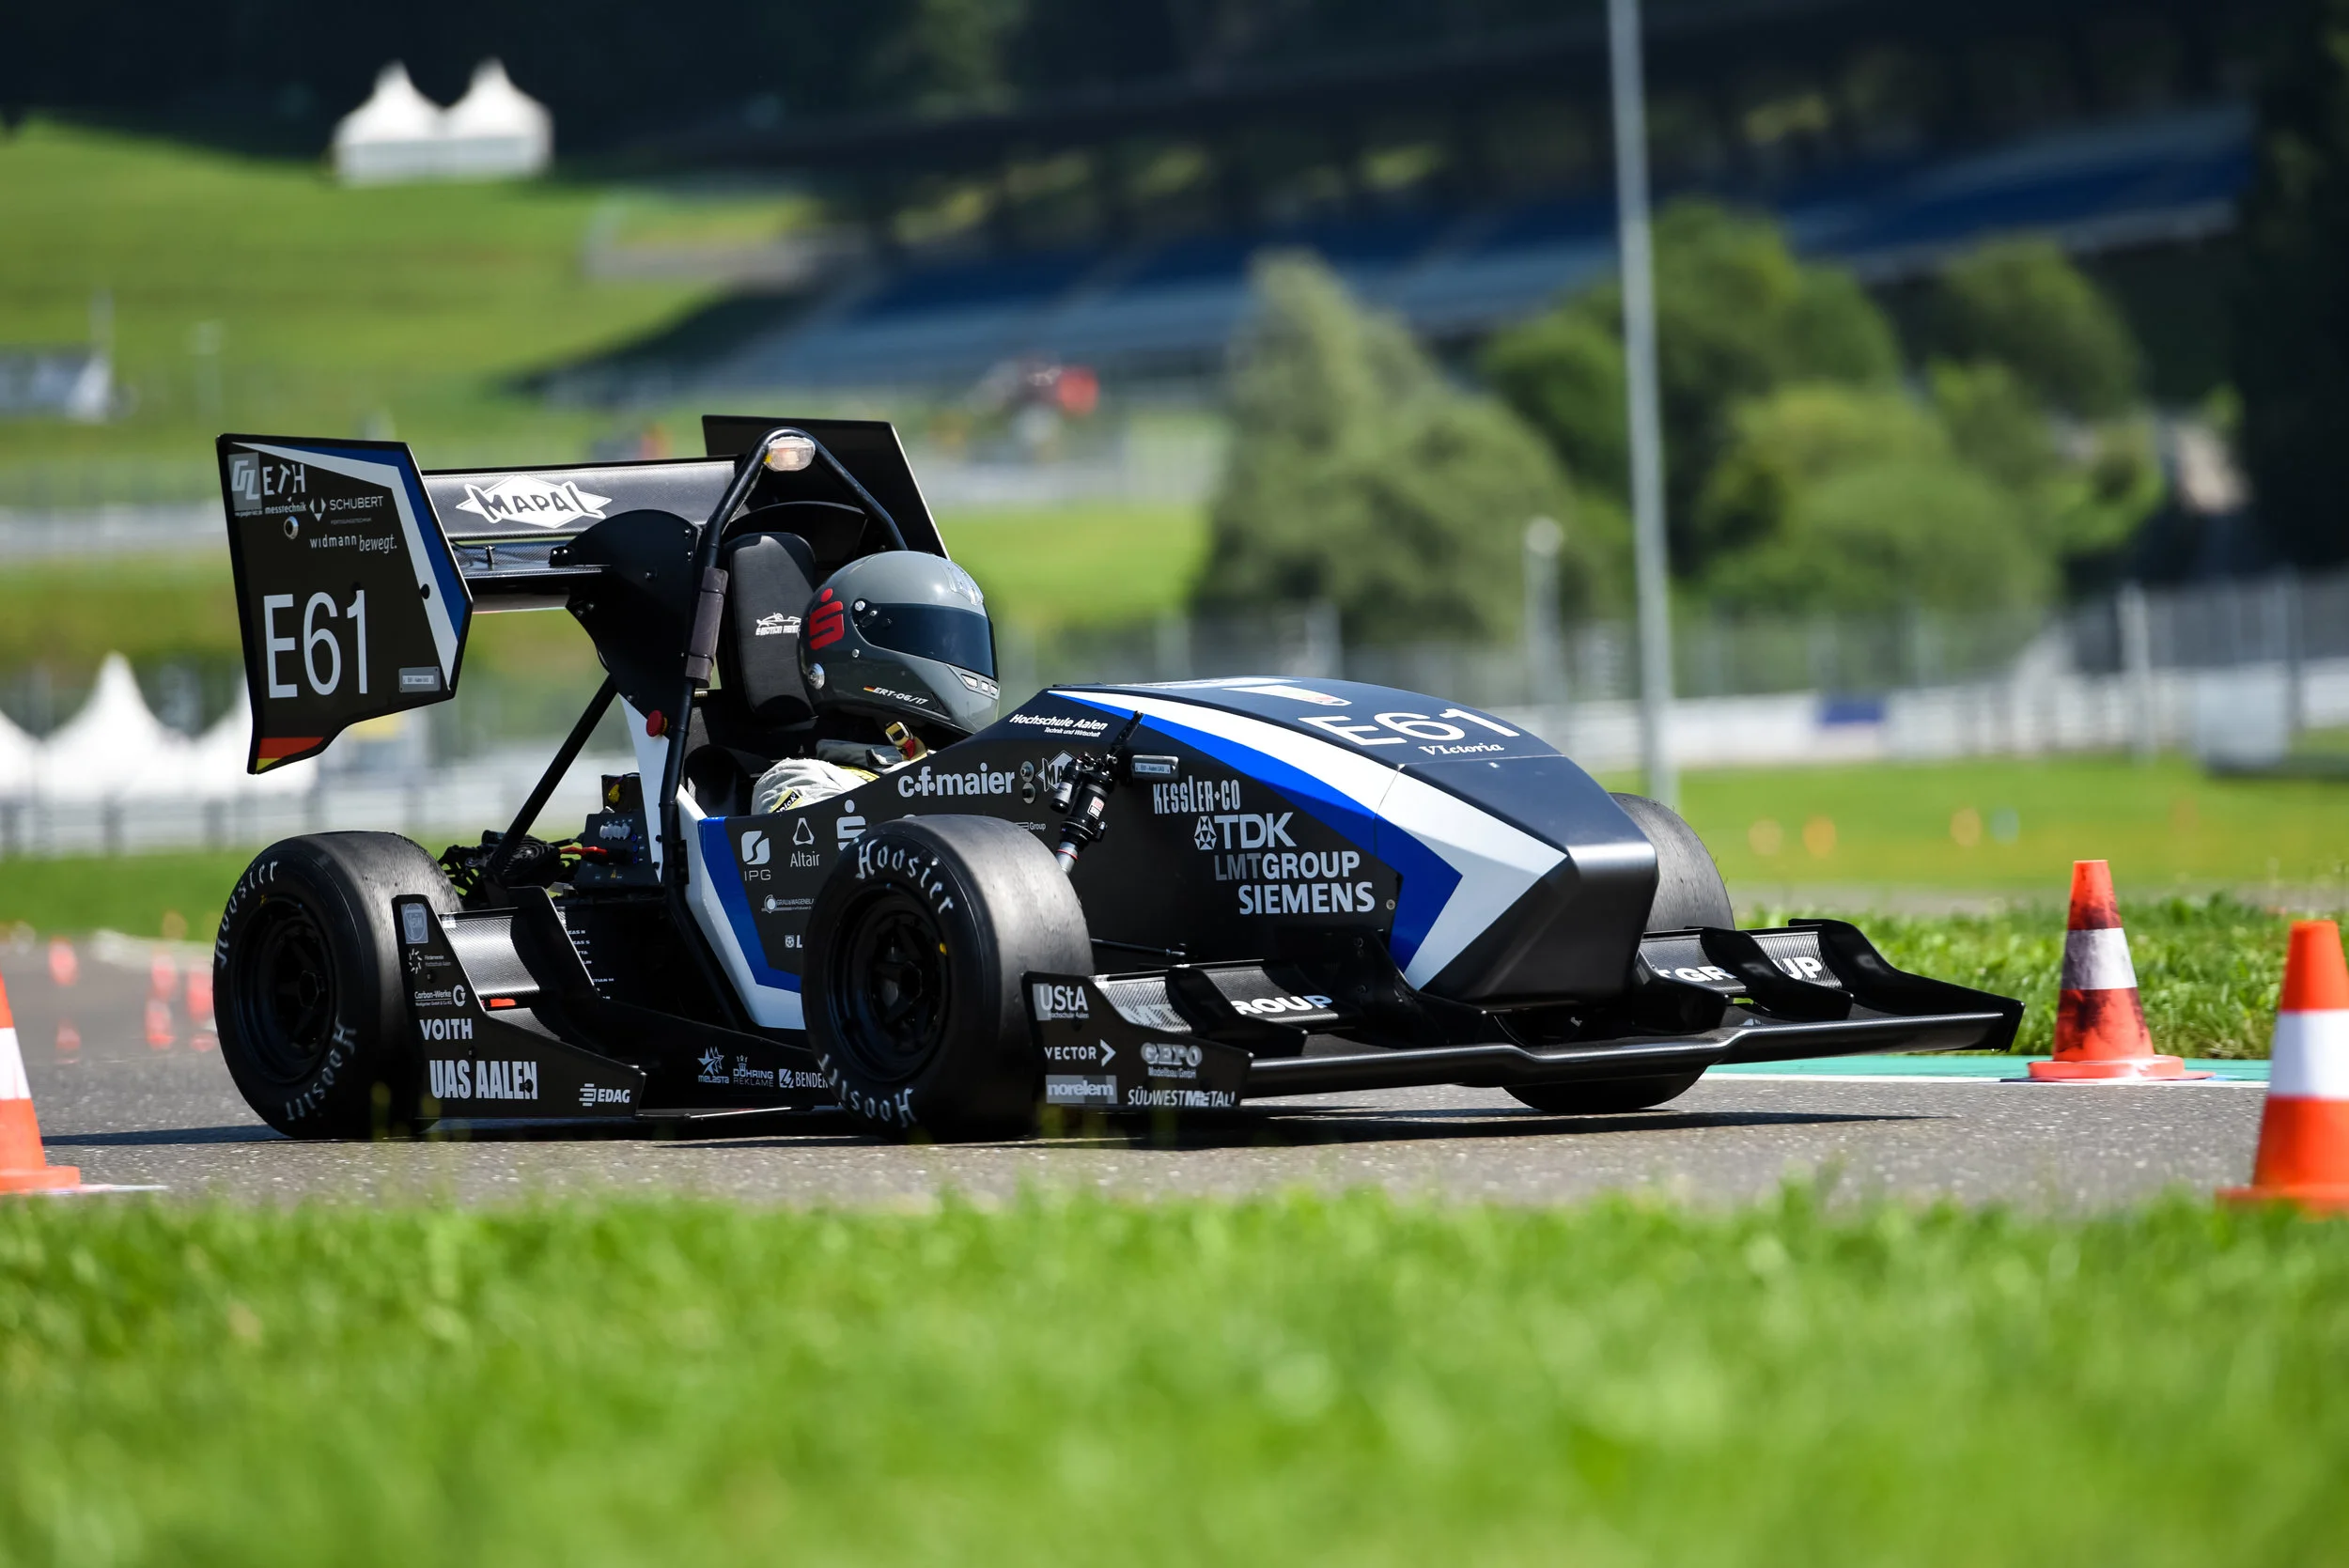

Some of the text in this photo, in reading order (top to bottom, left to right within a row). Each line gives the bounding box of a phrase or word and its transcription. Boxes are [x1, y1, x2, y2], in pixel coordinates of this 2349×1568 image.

[329, 496, 384, 511] SCHUBERT
[465, 483, 608, 523] MAPAL
[309, 534, 397, 554] widmann bewegt.
[263, 589, 368, 699] E61
[1008, 713, 1109, 731] Hochschule Aalen
[1297, 707, 1520, 747] E61
[1214, 812, 1298, 849] TDK
[790, 850, 820, 868] Altair
[743, 869, 771, 881] IPG
[855, 838, 955, 915] Hoosier
[1237, 881, 1376, 915] SIEMENS
[413, 990, 452, 1000] Carbon-Werke
[1039, 985, 1089, 1012] UStA
[1230, 995, 1333, 1016] ROUP
[419, 1018, 473, 1040] VOITH
[1044, 1046, 1097, 1061] VECTOR
[429, 1060, 538, 1100] UAS AALEN
[733, 1078, 774, 1087] REKLAME
[1046, 1080, 1113, 1096] norelem
[598, 1088, 630, 1104] EDAG
